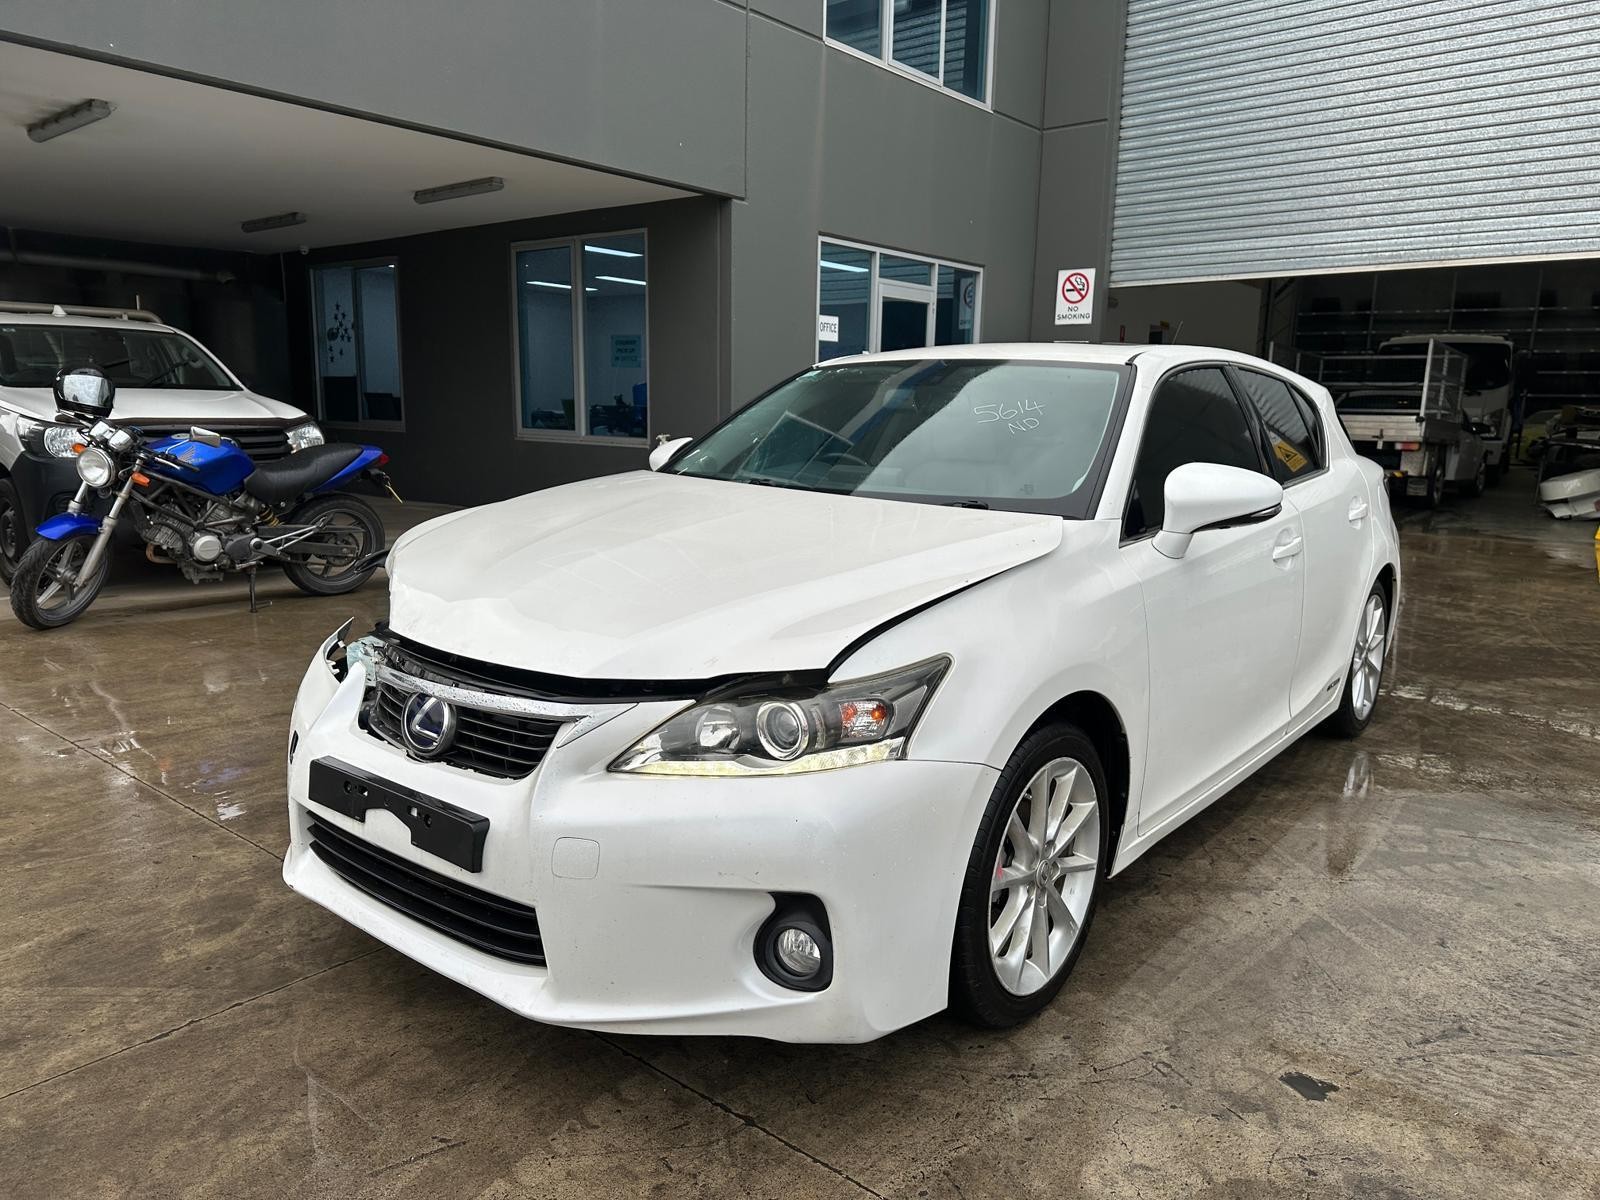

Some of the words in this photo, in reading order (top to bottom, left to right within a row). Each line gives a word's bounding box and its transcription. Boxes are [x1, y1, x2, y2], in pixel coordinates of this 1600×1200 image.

[1056, 312, 1091, 321] SMOKING
[819, 321, 837, 333] OFFICE
[974, 399, 1047, 424] 5614
